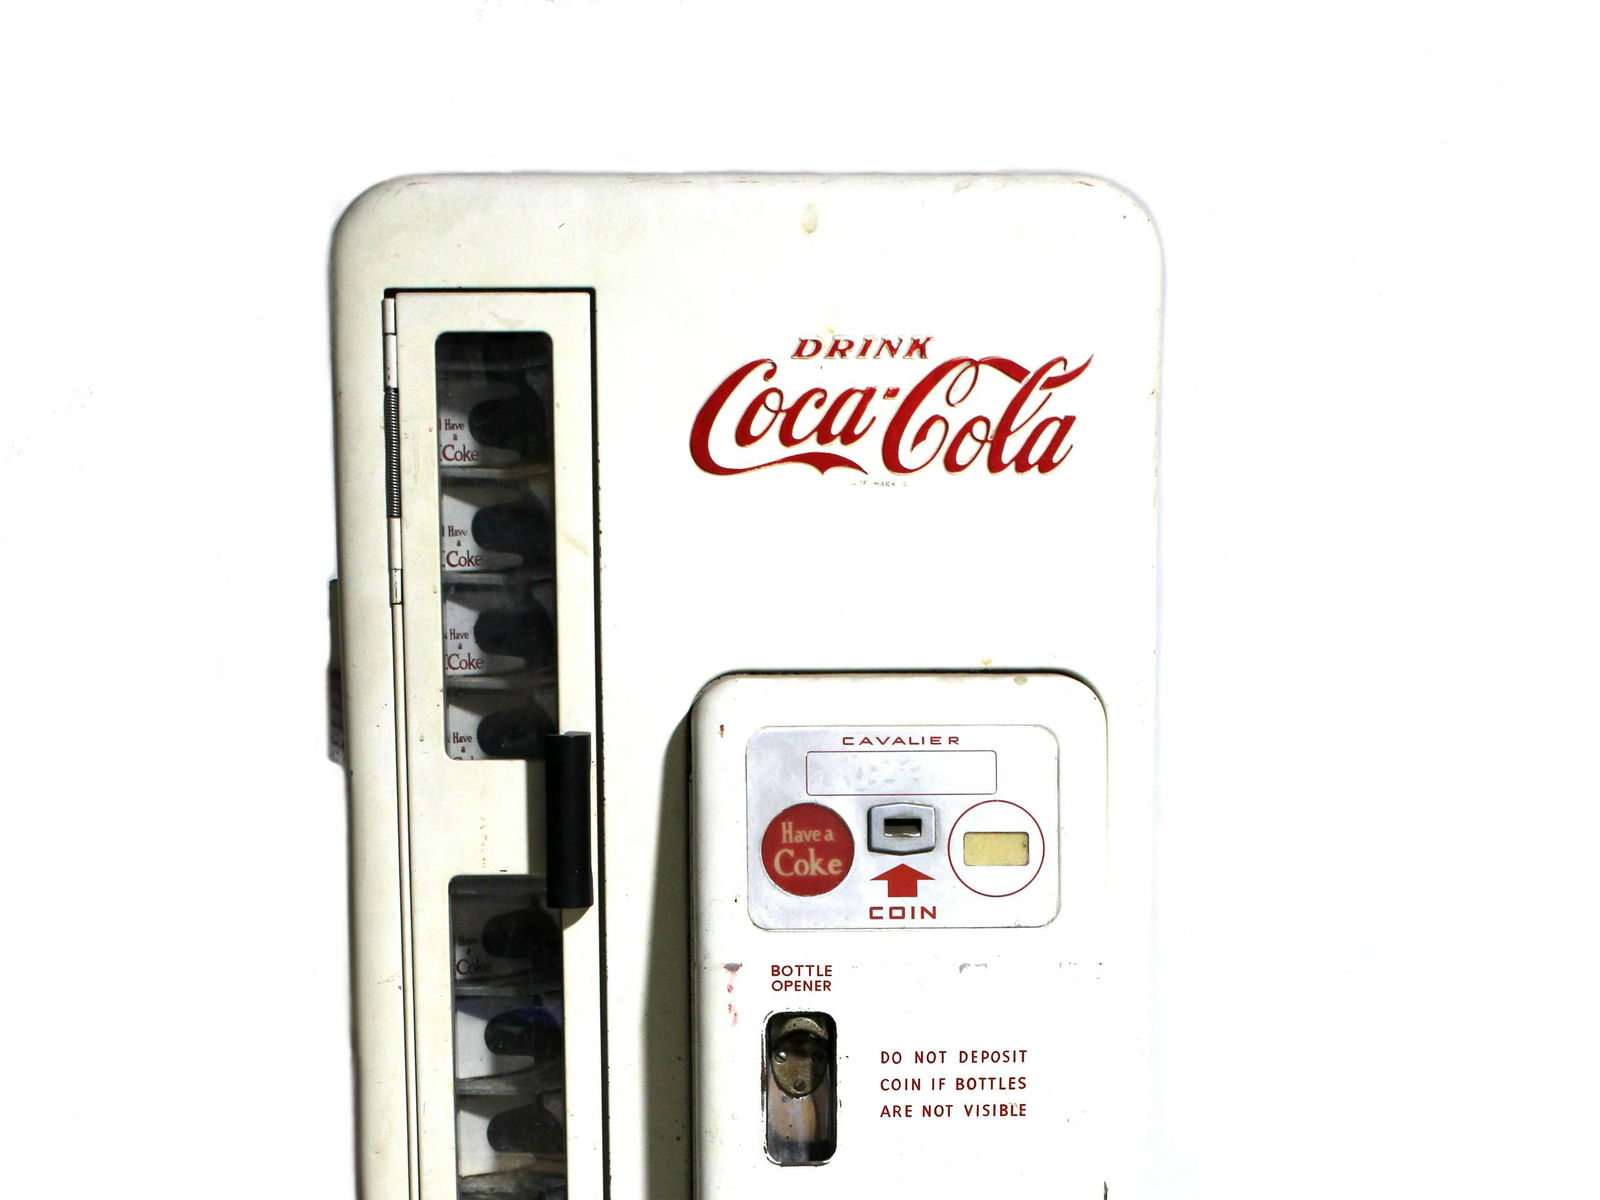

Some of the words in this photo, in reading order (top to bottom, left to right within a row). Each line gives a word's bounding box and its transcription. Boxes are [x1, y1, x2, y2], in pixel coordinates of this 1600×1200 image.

[791, 336, 932, 360] DRINK
[689, 352, 1094, 476] Coca-Cola
[445, 418, 465, 431] Have
[442, 444, 479, 462] Coke
[448, 525, 469, 537] Have
[446, 549, 482, 568] Coke
[449, 628, 470, 640] Have
[448, 652, 484, 670] Coke
[453, 731, 473, 744] Have
[842, 736, 960, 746] CAVALIER
[781, 821, 820, 844] Have
[824, 828, 834, 841] a
[774, 847, 842, 876] Coke
[869, 905, 937, 920] COIN
[456, 957, 491, 975] Coke
[771, 964, 833, 977] BOTTLE
[771, 979, 832, 992] OPENER
[880, 1050, 902, 1065] DO
[914, 1050, 947, 1064] NOT
[959, 1049, 1028, 1064] DEPOSIT
[880, 1077, 921, 1092] COIN
[931, 1077, 946, 1091] IF
[955, 1076, 1027, 1091] BOTTLES
[880, 1104, 913, 1118] ARE
[922, 1104, 954, 1118] NOT
[964, 1103, 1027, 1118] VISIBLE
